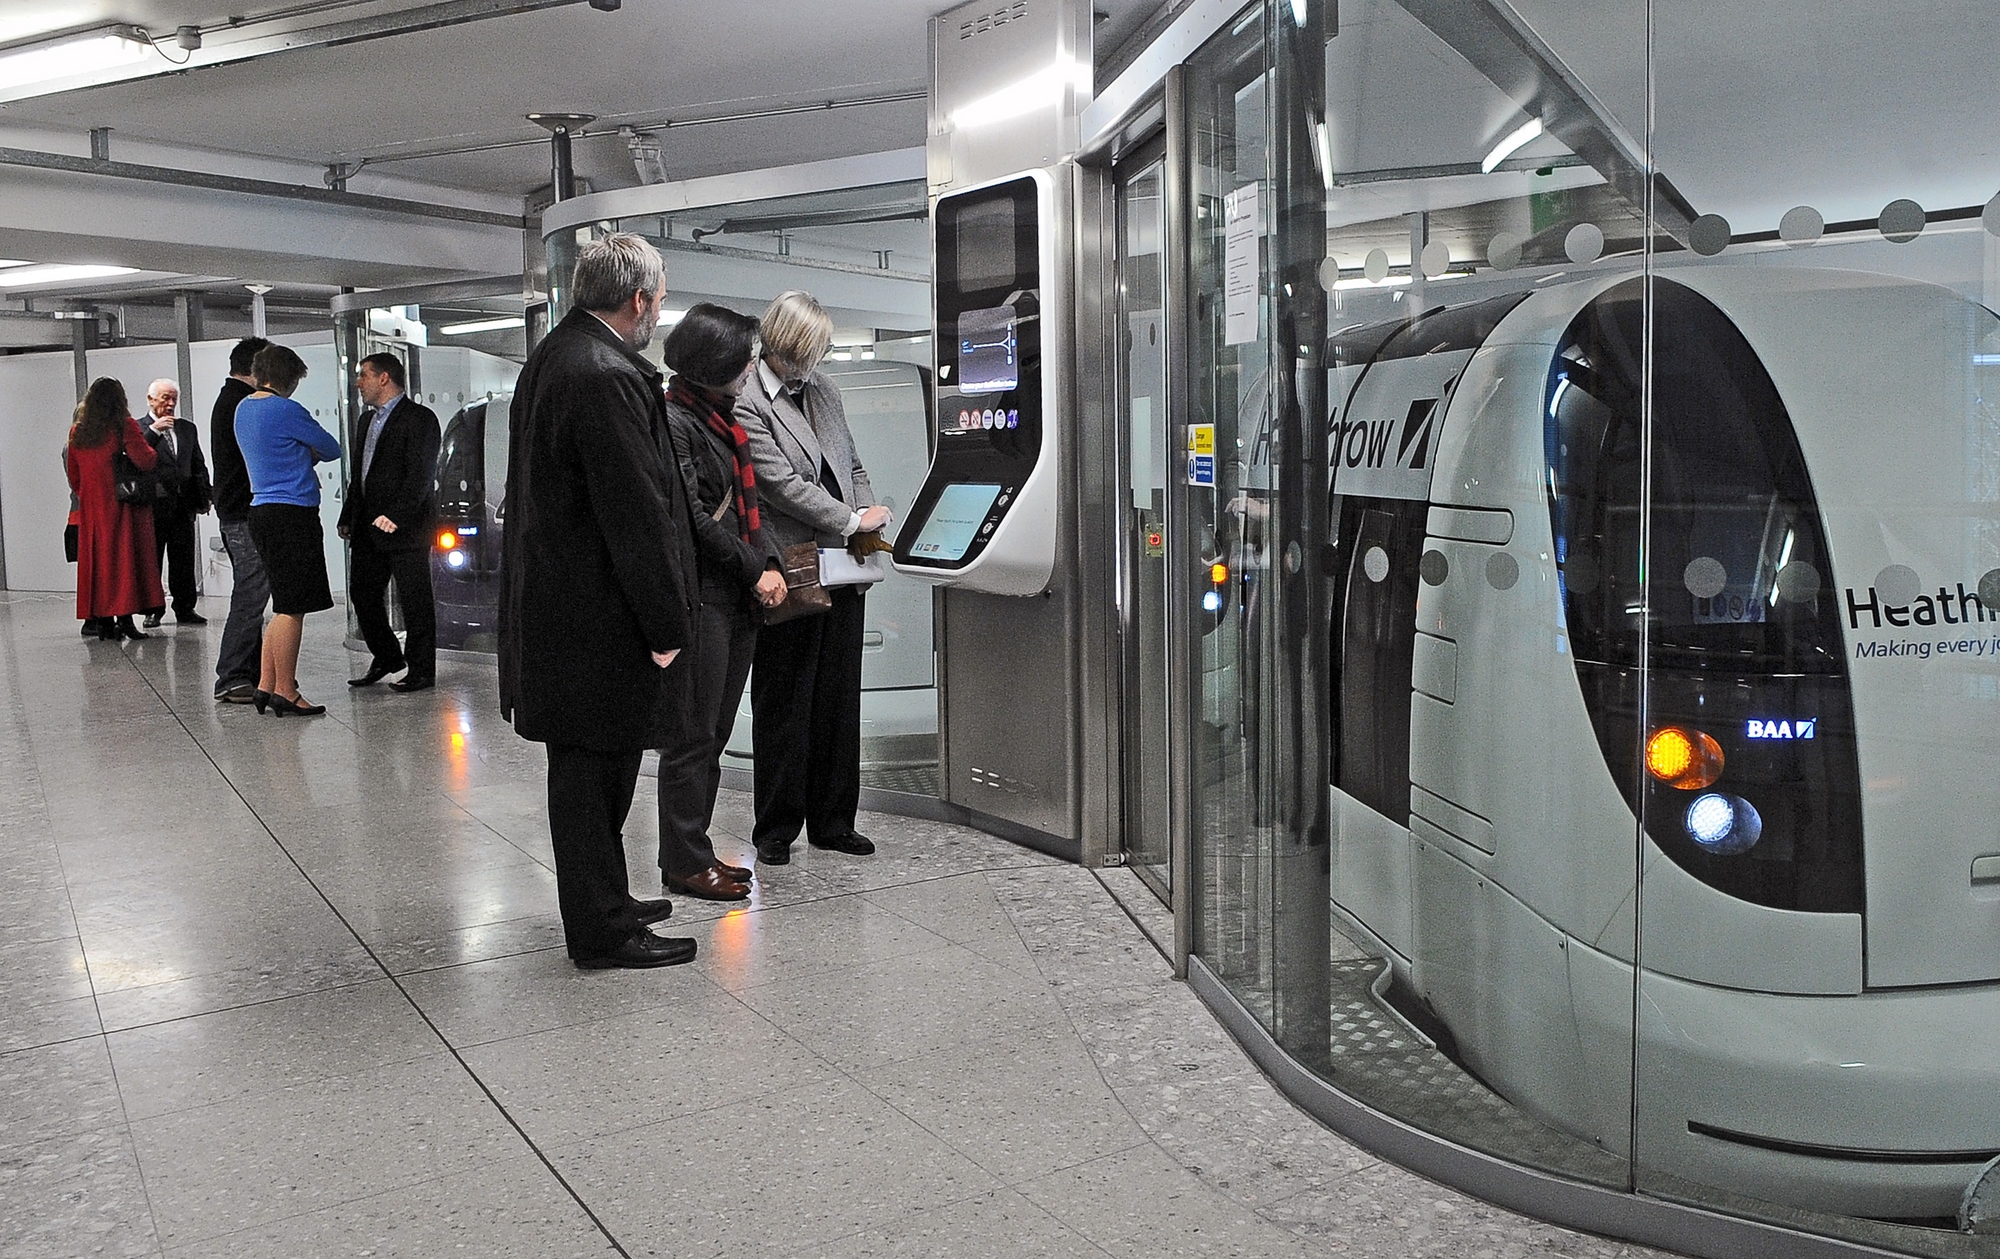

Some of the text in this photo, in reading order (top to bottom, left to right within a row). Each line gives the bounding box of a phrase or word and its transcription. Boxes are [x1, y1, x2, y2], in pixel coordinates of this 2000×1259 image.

[1845, 582, 1998, 629] Heath
[1855, 639, 1931, 659] Making
[1936, 638, 1988, 656] every
[1747, 719, 1793, 739] BAA
